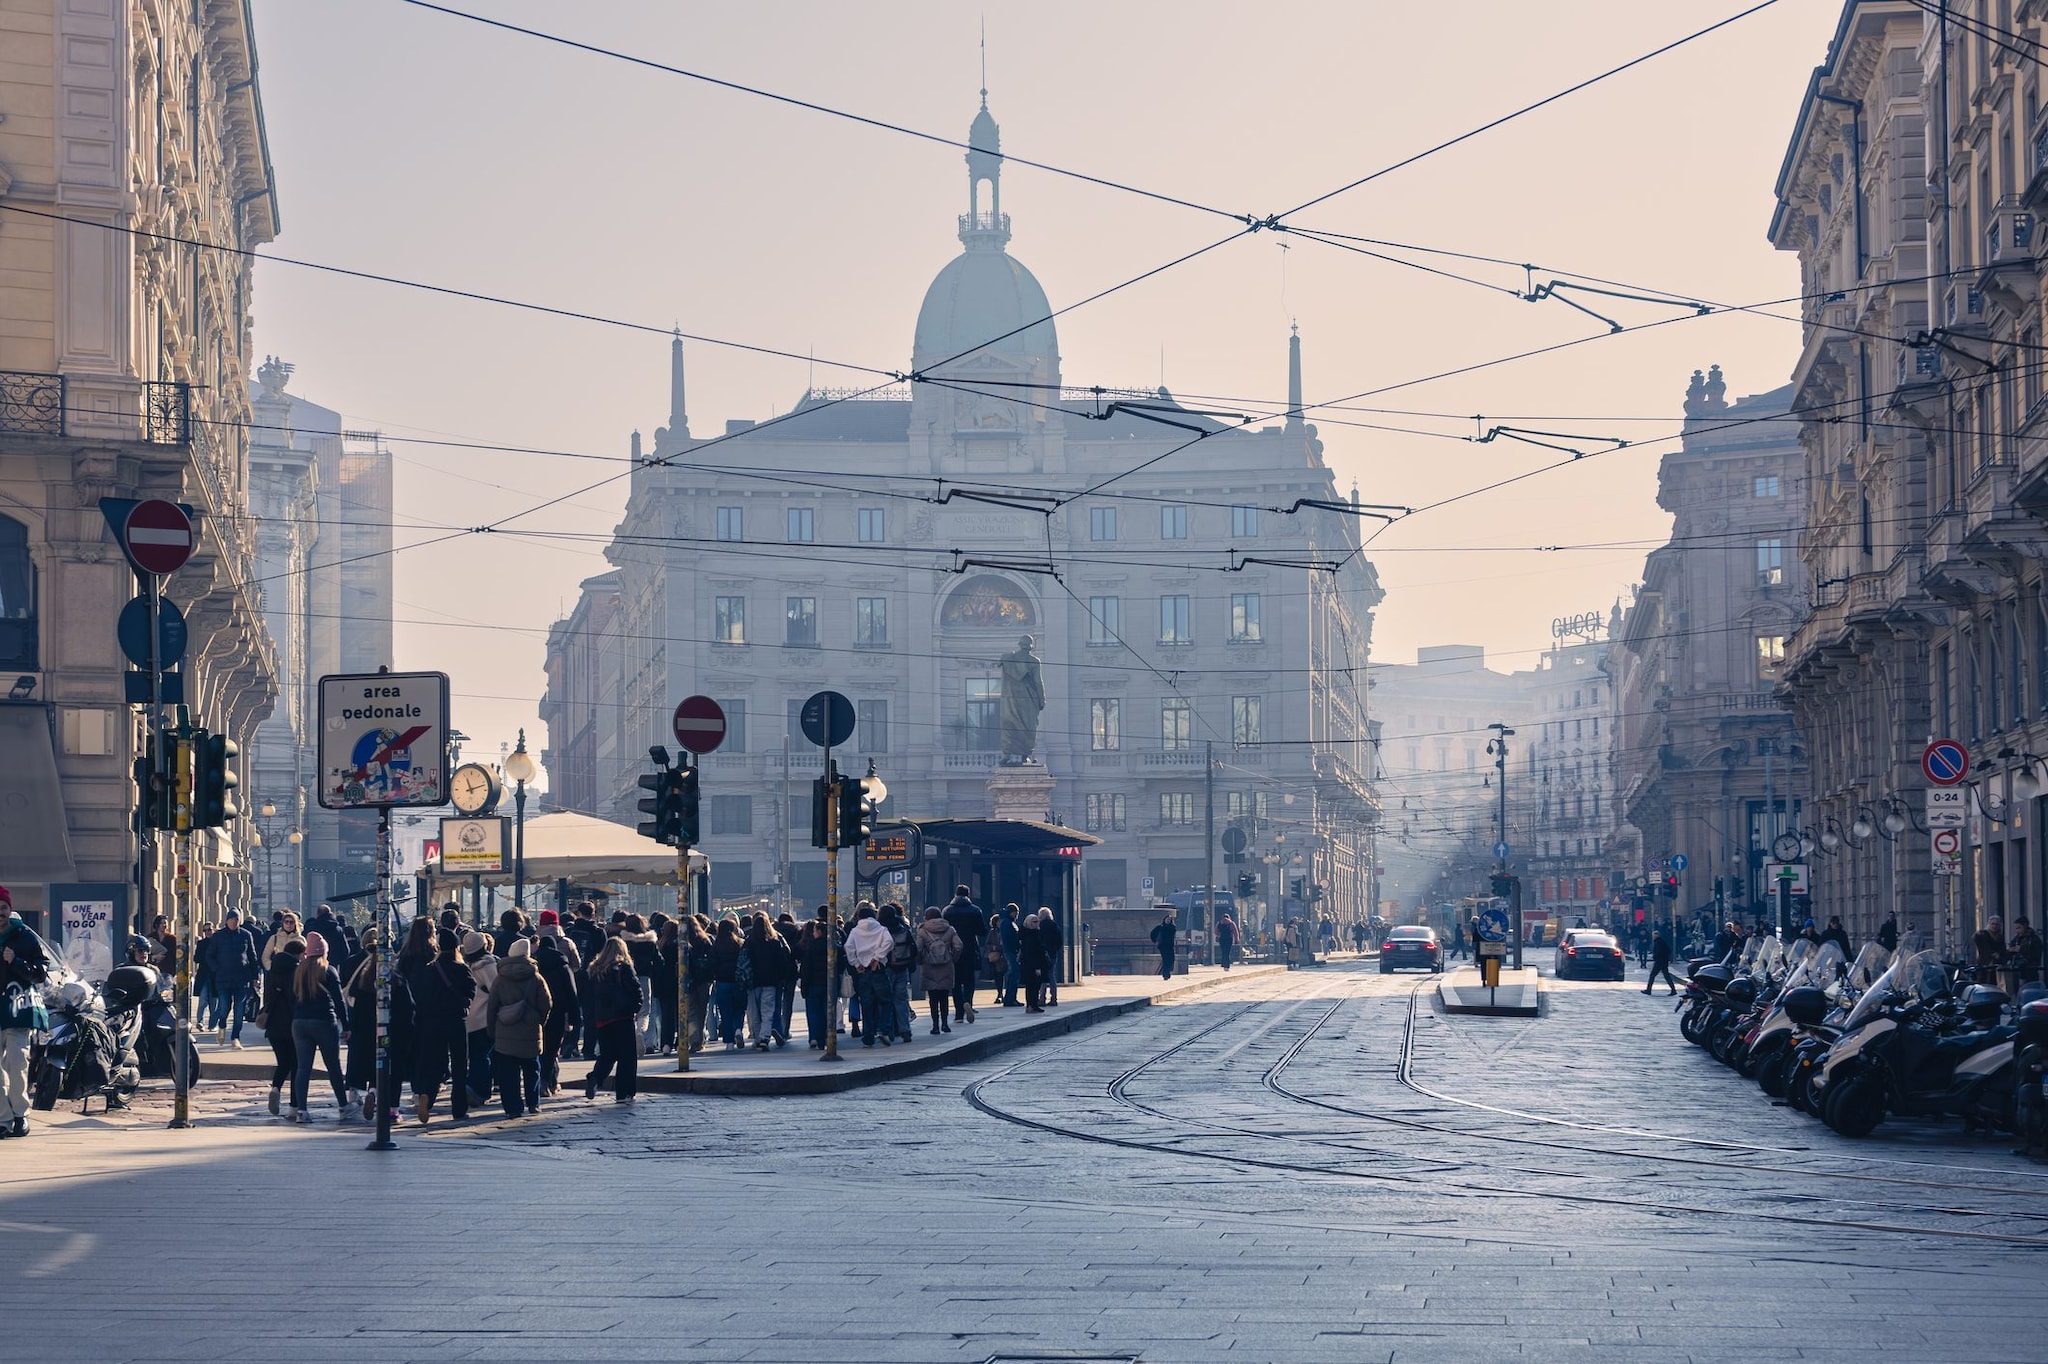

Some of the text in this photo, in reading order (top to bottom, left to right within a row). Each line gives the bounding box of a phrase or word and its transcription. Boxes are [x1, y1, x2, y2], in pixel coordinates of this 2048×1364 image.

[1552, 610, 1600, 638] GUCCI
[364, 686, 401, 698] area
[342, 703, 422, 721] pedonale
[1934, 793, 1958, 802] 0-24
[71, 905, 92, 913] ONE
[81, 912, 106, 920] YEAR
[67, 920, 96, 928] TO GO
